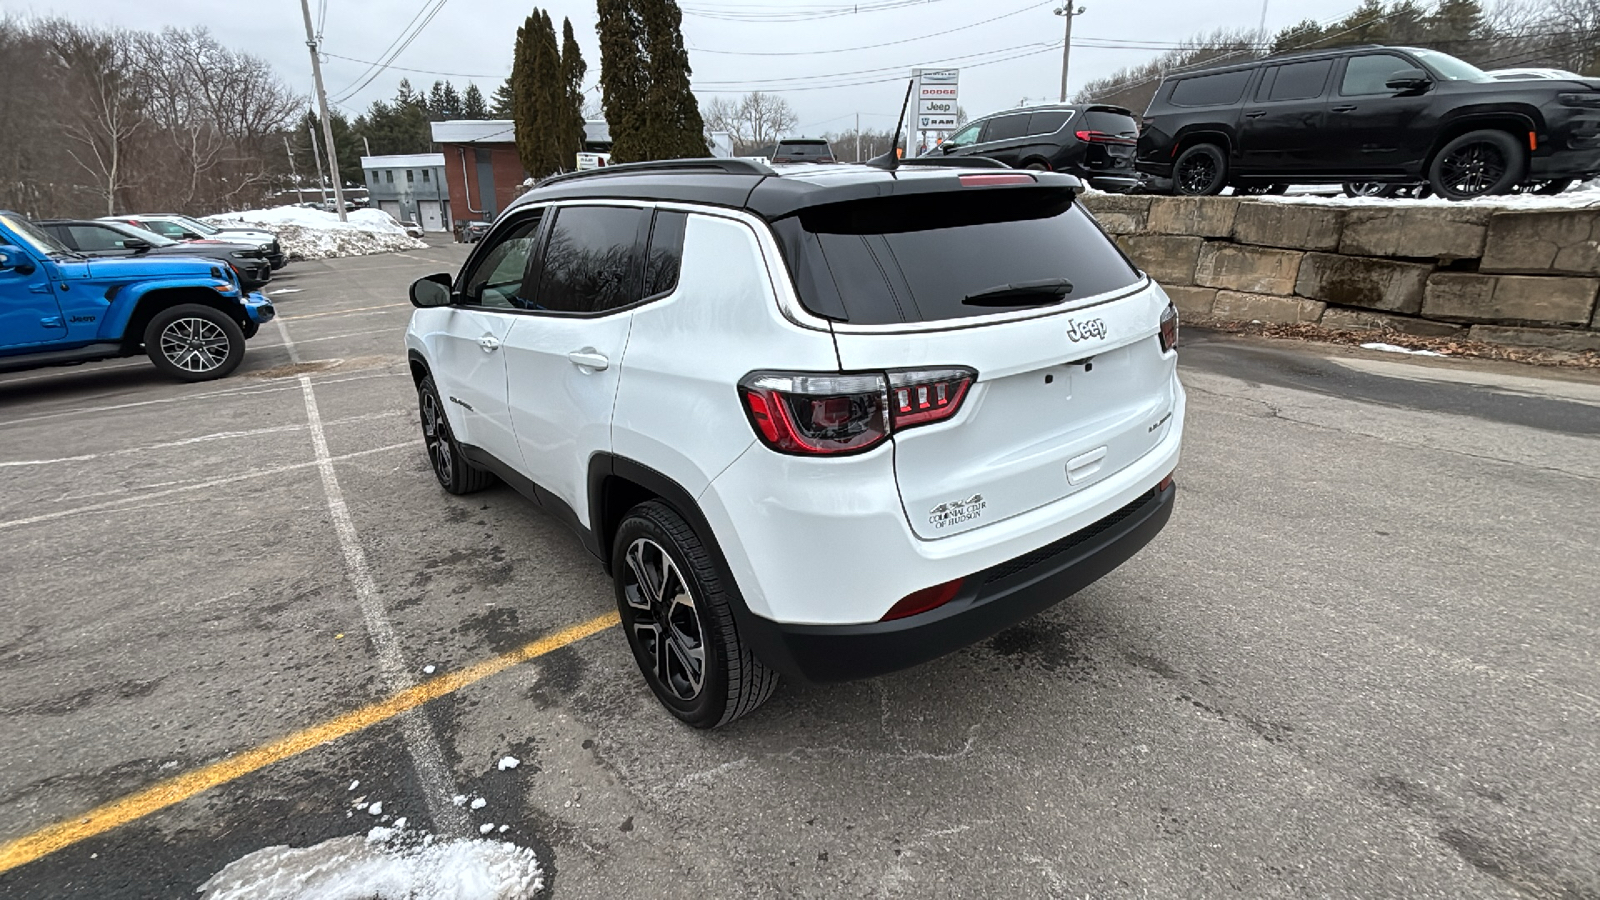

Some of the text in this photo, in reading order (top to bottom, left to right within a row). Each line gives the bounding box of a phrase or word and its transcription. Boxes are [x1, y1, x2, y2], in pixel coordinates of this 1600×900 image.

[926, 101, 951, 112] Jeep
[70, 315, 96, 323] Jeep
[1066, 318, 1107, 343] Jeep
[948, 510, 981, 526] HUDSON
